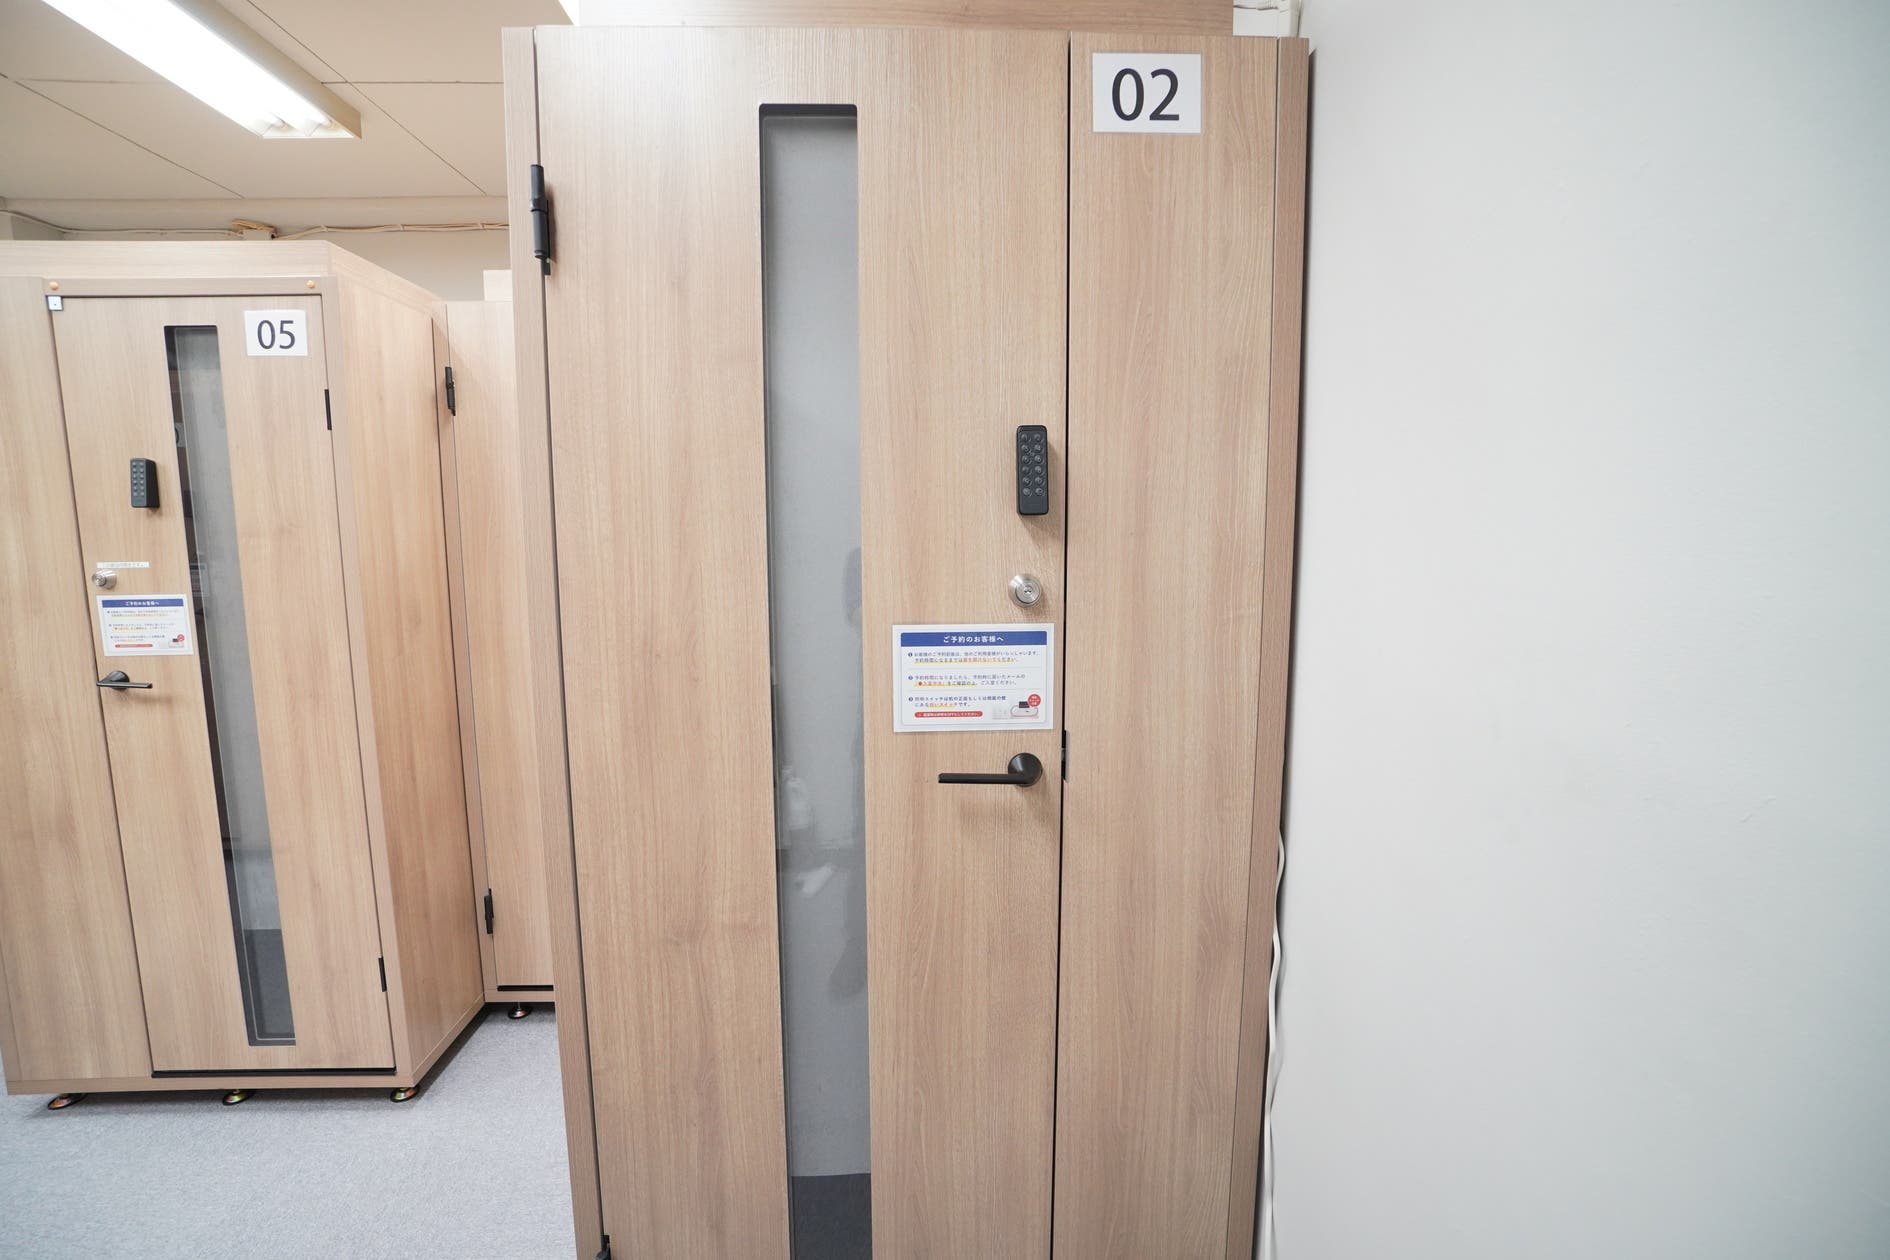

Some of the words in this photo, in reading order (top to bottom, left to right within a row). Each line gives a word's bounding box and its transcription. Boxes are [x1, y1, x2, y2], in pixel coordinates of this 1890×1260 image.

[1111, 68, 1180, 121] 02
[257, 320, 296, 349] 05
[943, 635, 1004, 643] ご予約のお客様へ
